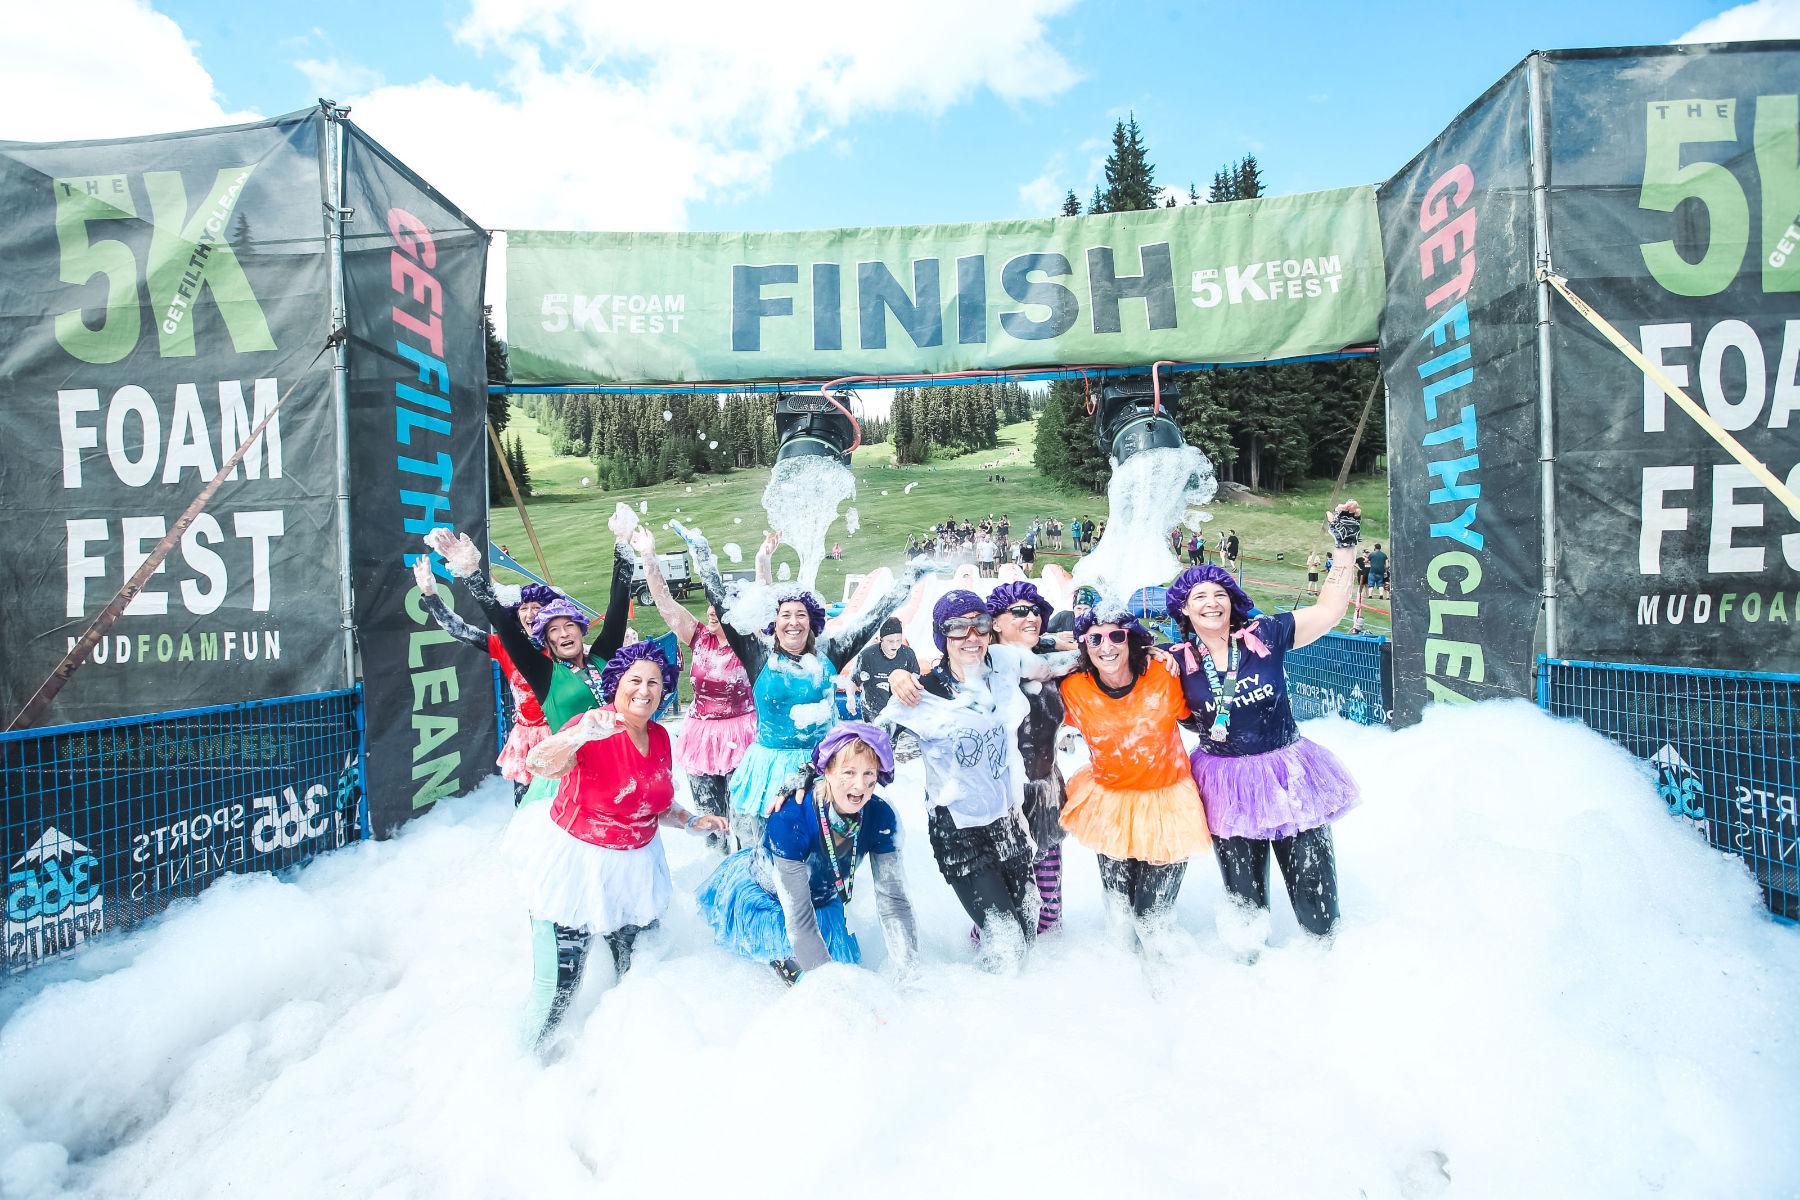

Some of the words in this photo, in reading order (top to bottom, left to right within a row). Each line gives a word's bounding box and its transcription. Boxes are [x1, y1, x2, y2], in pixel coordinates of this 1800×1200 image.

[1655, 104, 1729, 120] THE
[60, 178, 124, 197] THE
[1769, 215, 1800, 268] GET
[54, 163, 279, 365] 5K
[1266, 255, 1342, 280] FOAM
[731, 241, 1178, 352] FINISH
[1192, 263, 1269, 308] 5K
[1268, 274, 1343, 300] FEST
[541, 293, 612, 333] 5K
[612, 294, 685, 314] FOAM
[612, 314, 685, 335] FEST
[57, 378, 283, 489] FOAM
[66, 510, 285, 618] FEST
[1637, 591, 1800, 625] MUDFOA
[1205, 684, 1275, 713] MTHER
